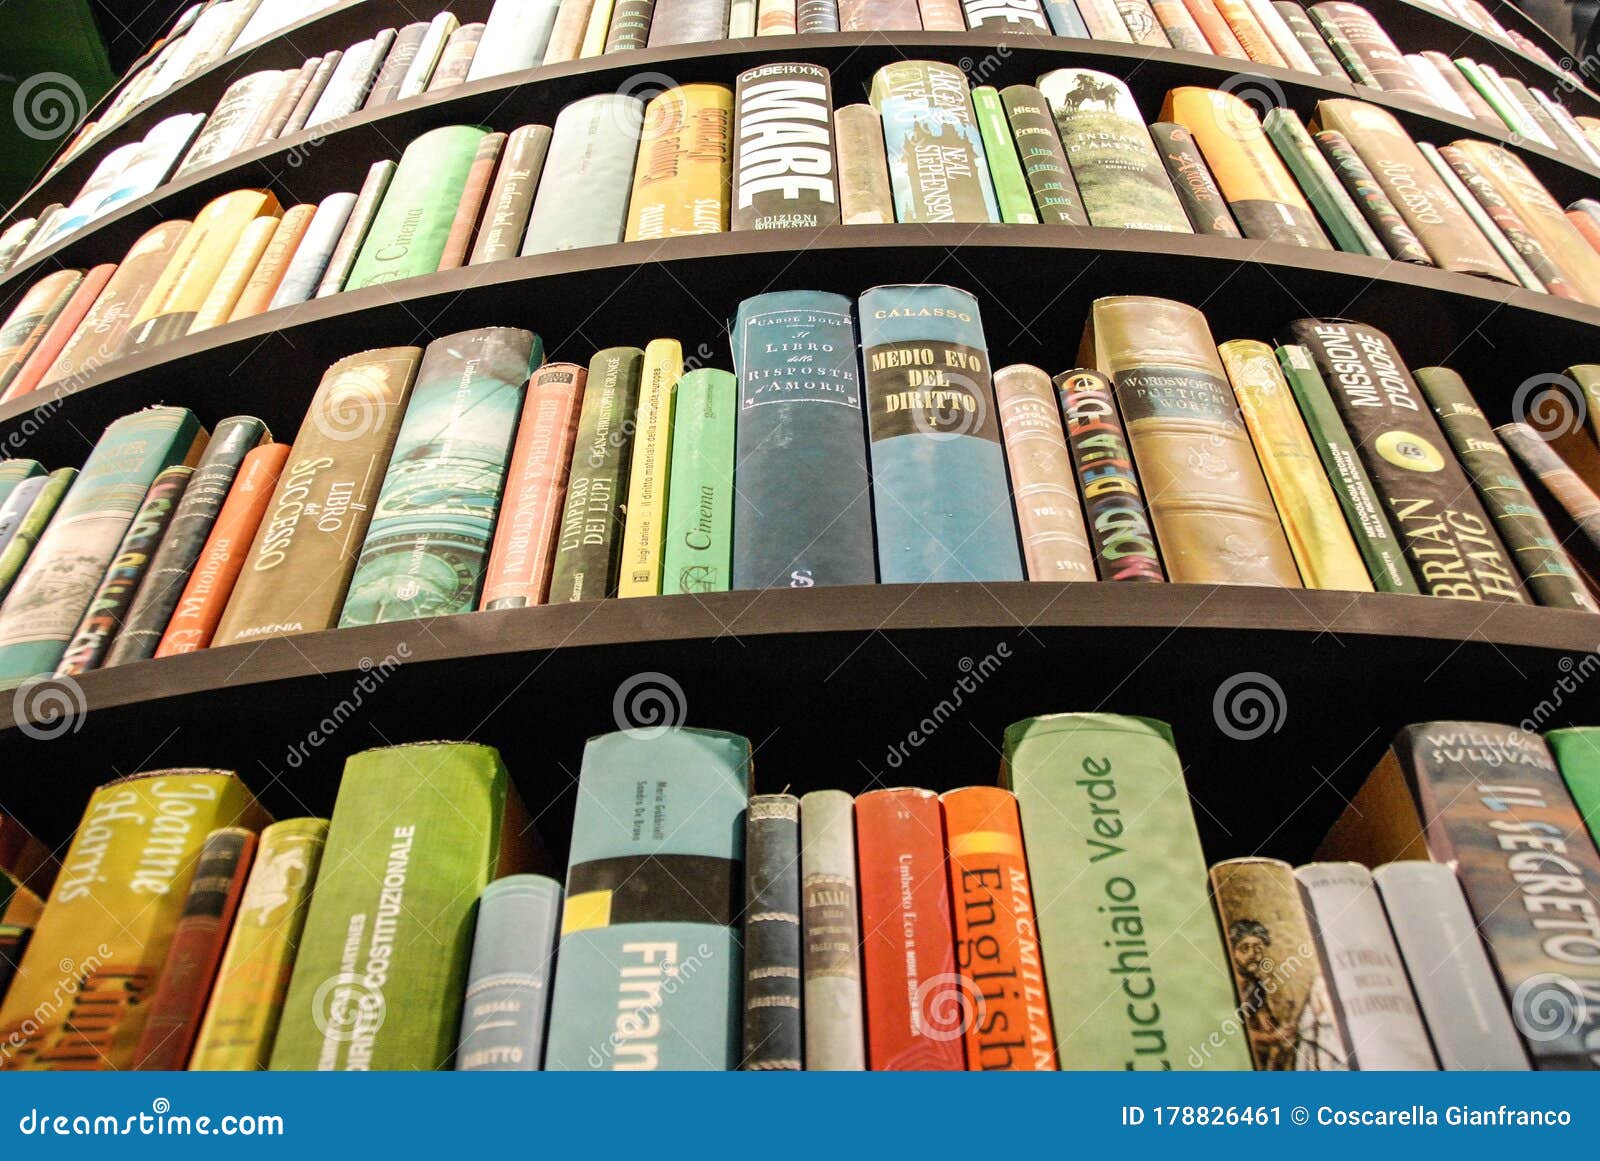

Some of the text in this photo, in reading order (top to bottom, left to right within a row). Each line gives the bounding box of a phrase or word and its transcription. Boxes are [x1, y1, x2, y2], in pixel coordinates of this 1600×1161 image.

[739, 81, 834, 209] MARE
[942, 145, 966, 180] NEAL
[1015, 125, 1052, 139] French
[755, 213, 818, 227] EDIZIONI
[925, 144, 955, 223] STEPHENSON
[1044, 181, 1063, 191] nel
[374, 206, 425, 263] Cinema
[766, 343, 834, 354] LIBRO
[875, 307, 972, 323] CALASSO
[748, 366, 853, 382] RISPOSTE
[872, 348, 982, 372] MEDIO EVO
[908, 369, 951, 388] DEL
[1315, 325, 1383, 408] MISSIONE
[1356, 332, 1419, 411] D'ONORE
[885, 392, 977, 414] DIRITTO
[253, 455, 334, 572] SUCCESSO
[318, 480, 356, 533] LIBRO
[502, 398, 554, 574] BIBLIOTHECA SANCTORUM
[561, 477, 590, 553] L'IMPERO
[583, 477, 613, 546] DEI LUPI
[639, 546, 649, 565] luigi
[644, 475, 653, 500] diritto
[685, 485, 715, 551] Cinema
[178, 536, 231, 619] Mitologia
[1390, 497, 1482, 601] BRIAN
[1455, 510, 1524, 603] HAIG
[234, 622, 304, 641] ARMENIA
[58, 789, 143, 904] Harris
[130, 781, 217, 895] Joanne
[1077, 755, 1123, 865] Verde
[367, 824, 416, 992] COSTITUZIONALE
[898, 853, 912, 909] Umberto
[1478, 784, 1600, 968] IL SEGRETO
[903, 911, 917, 939] Eco
[613, 940, 679, 1071] Finan
[957, 866, 1026, 1071] English
[1008, 868, 1055, 1071] MACMILLAN
